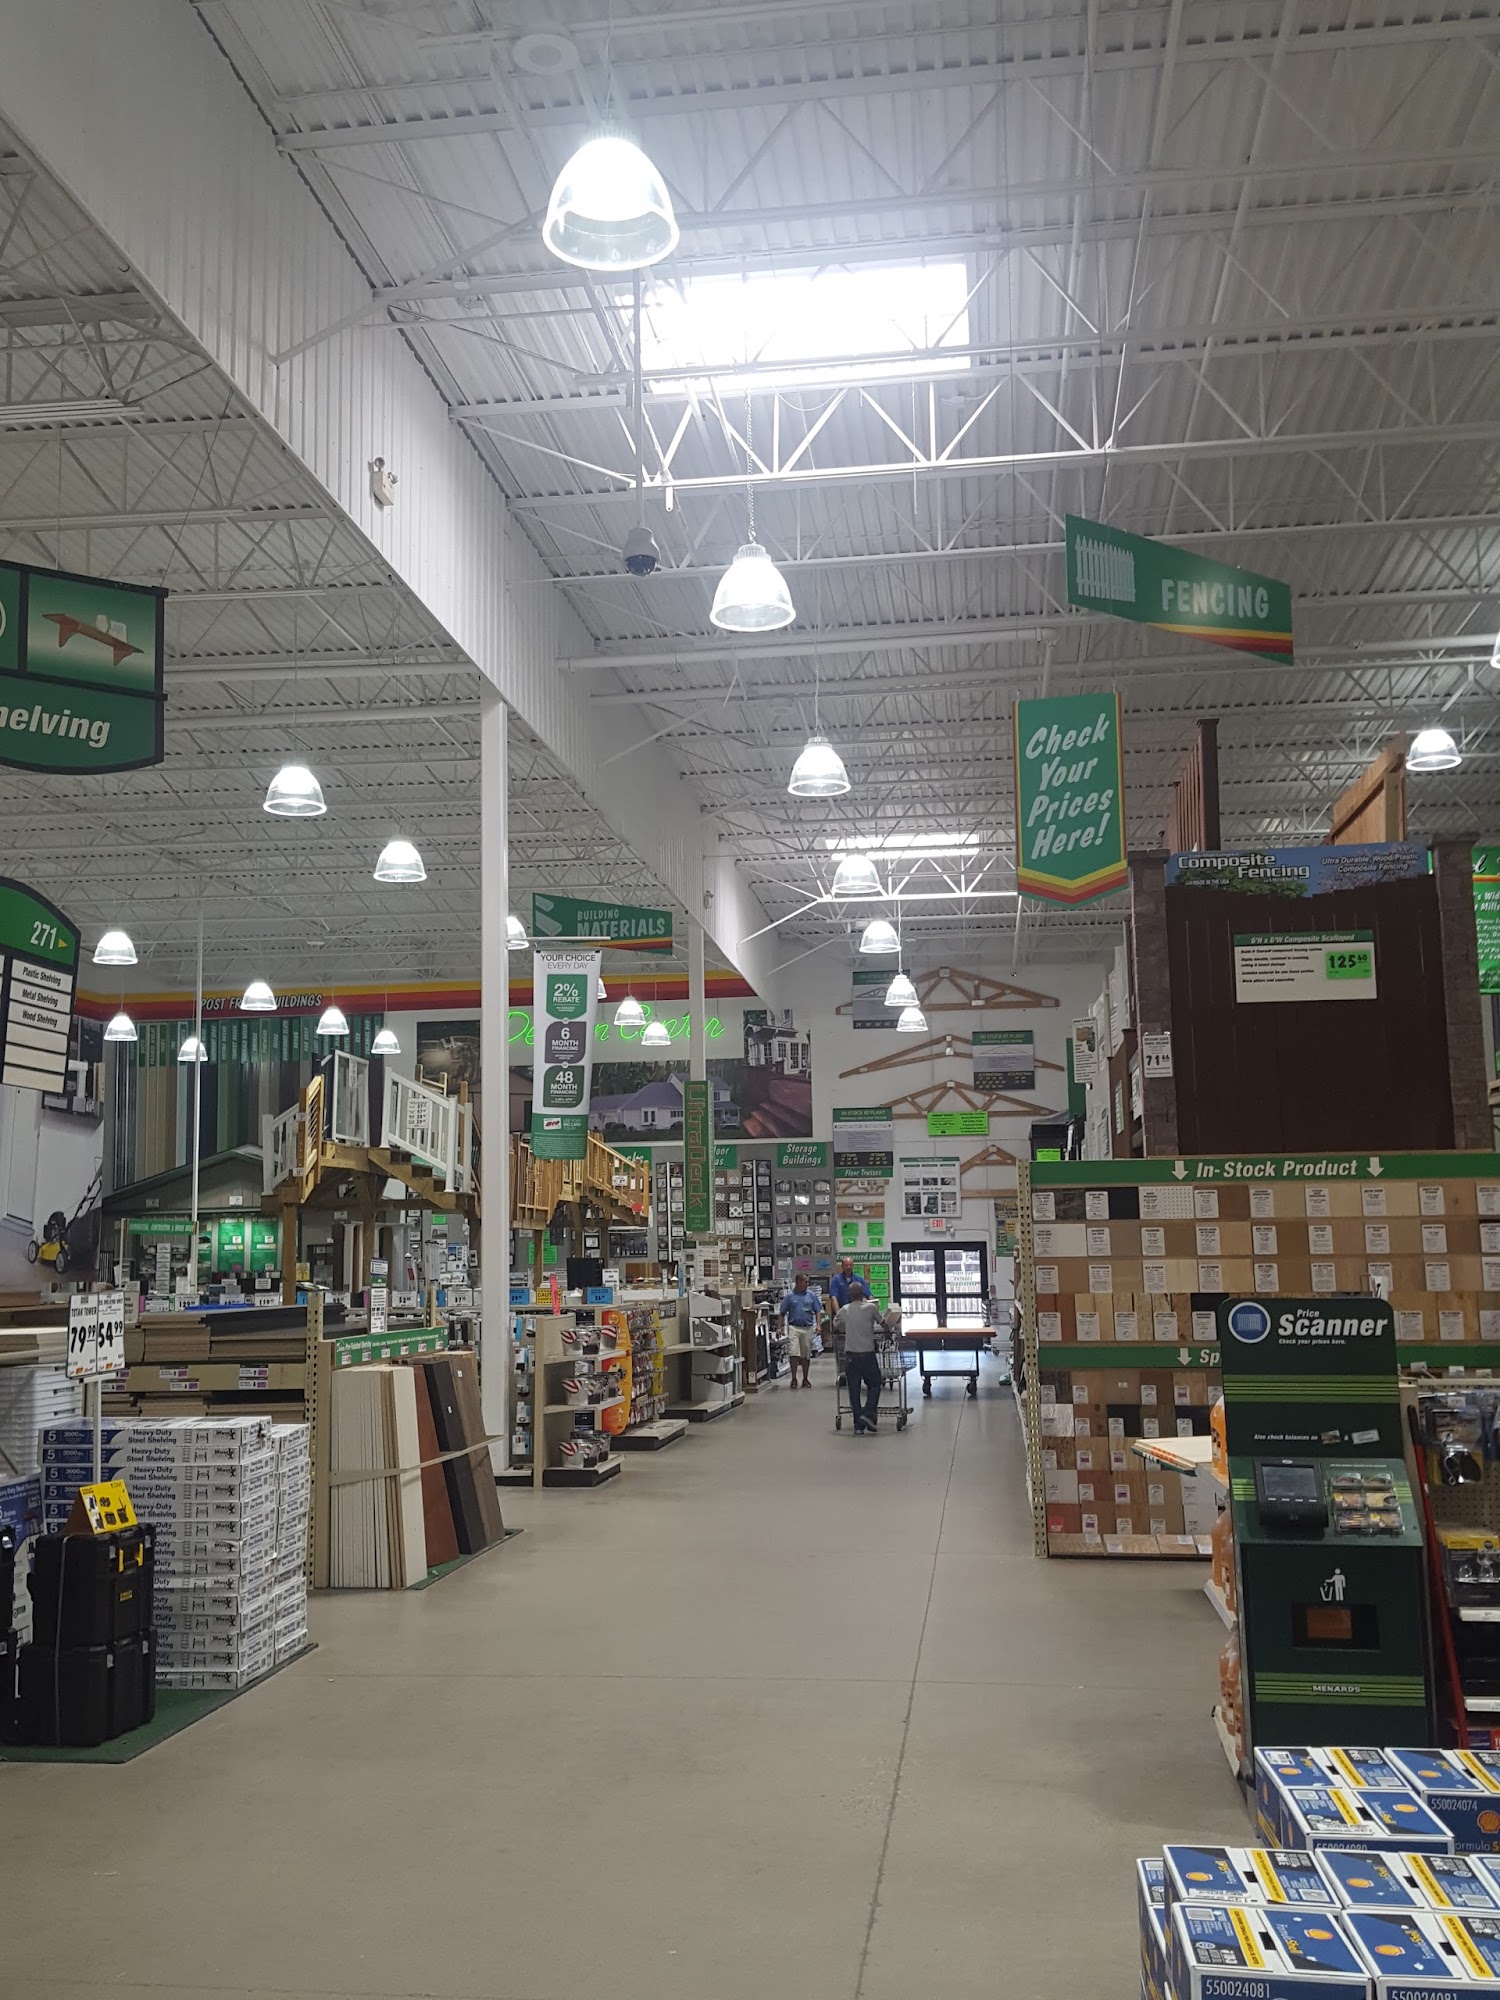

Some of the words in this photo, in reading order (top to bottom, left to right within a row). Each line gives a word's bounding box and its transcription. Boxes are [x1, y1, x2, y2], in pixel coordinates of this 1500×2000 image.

[1161, 577, 1270, 619] FENCING
[1025, 712, 1110, 759] Check
[1039, 756, 1098, 791] Your
[1026, 789, 1114, 828] Prices
[1031, 812, 1108, 860] Here!
[1178, 853, 1276, 870] Composite
[1238, 864, 1310, 879] Fencing
[1338, 865, 1376, 873] Composite
[1379, 863, 1408, 871] Fencing
[577, 909, 619, 922] BUILDING
[576, 917, 666, 938] MATERIALS
[30, 920, 57, 950] 271
[1284, 935, 1320, 943] Composite
[1321, 934, 1355, 942] Scalloped
[541, 954, 563, 962] YOUR
[565, 954, 596, 962] CHOICE
[1329, 954, 1357, 969] 125
[22, 967, 39, 980] Plastic
[40, 972, 61, 987] Shelving
[554, 983, 579, 997] 2%
[22, 988, 36, 1000] Metal
[37, 992, 58, 1007] Shelving
[200, 997, 225, 1011] POST
[276, 994, 322, 1009] UILDINGS
[22, 1010, 36, 1022] Wood
[36, 1013, 58, 1028] Shelving
[561, 1027, 570, 1039] 6
[1146, 1054, 1160, 1066] 71
[555, 1071, 573, 1083] 48
[688, 1084, 707, 1209] UltraDeck
[786, 1143, 818, 1154] Storage
[782, 1155, 822, 1166] Buildings
[845, 1169, 860, 1177] Floor
[1196, 1161, 1277, 1178] In-Stock
[1282, 1159, 1358, 1176] Product
[932, 1219, 944, 1228] EXIT
[84, 1306, 97, 1316] TOWER
[1296, 1308, 1320, 1319] Price
[1277, 1314, 1389, 1337] Scanner
[70, 1325, 87, 1354] 79
[87, 1324, 96, 1339] 99
[98, 1321, 114, 1348] 54
[114, 1320, 123, 1334] 99
[1312, 1338, 1330, 1346] prices
[48, 1430, 57, 1442] 5
[132, 1429, 173, 1438] Heavy-Duty
[128, 1436, 146, 1444] Steel
[147, 1436, 177, 1445] Shelving
[46, 1450, 56, 1461] 5
[131, 1447, 171, 1457] Heavy-Duty
[126, 1455, 145, 1463] Steel
[146, 1455, 175, 1464] Shelving
[49, 1468, 59, 1479] 5
[133, 1466, 174, 1476] Heavy-Duty
[148, 1474, 178, 1482] Shelving
[49, 1486, 58, 1497] 5
[132, 1484, 172, 1494] Heavy-Duty
[147, 1492, 176, 1501] Shelving
[49, 1505, 59, 1515] 5
[133, 1503, 173, 1512] Heavy-Duty
[147, 1510, 177, 1519] Shelving
[49, 1522, 58, 1533] 5
[155, 1529, 177, 1538] elving
[1312, 1684, 1361, 1694] MENARDS
[1431, 1798, 1478, 1811] 550024074
[1205, 1979, 1270, 1998] 550024081
